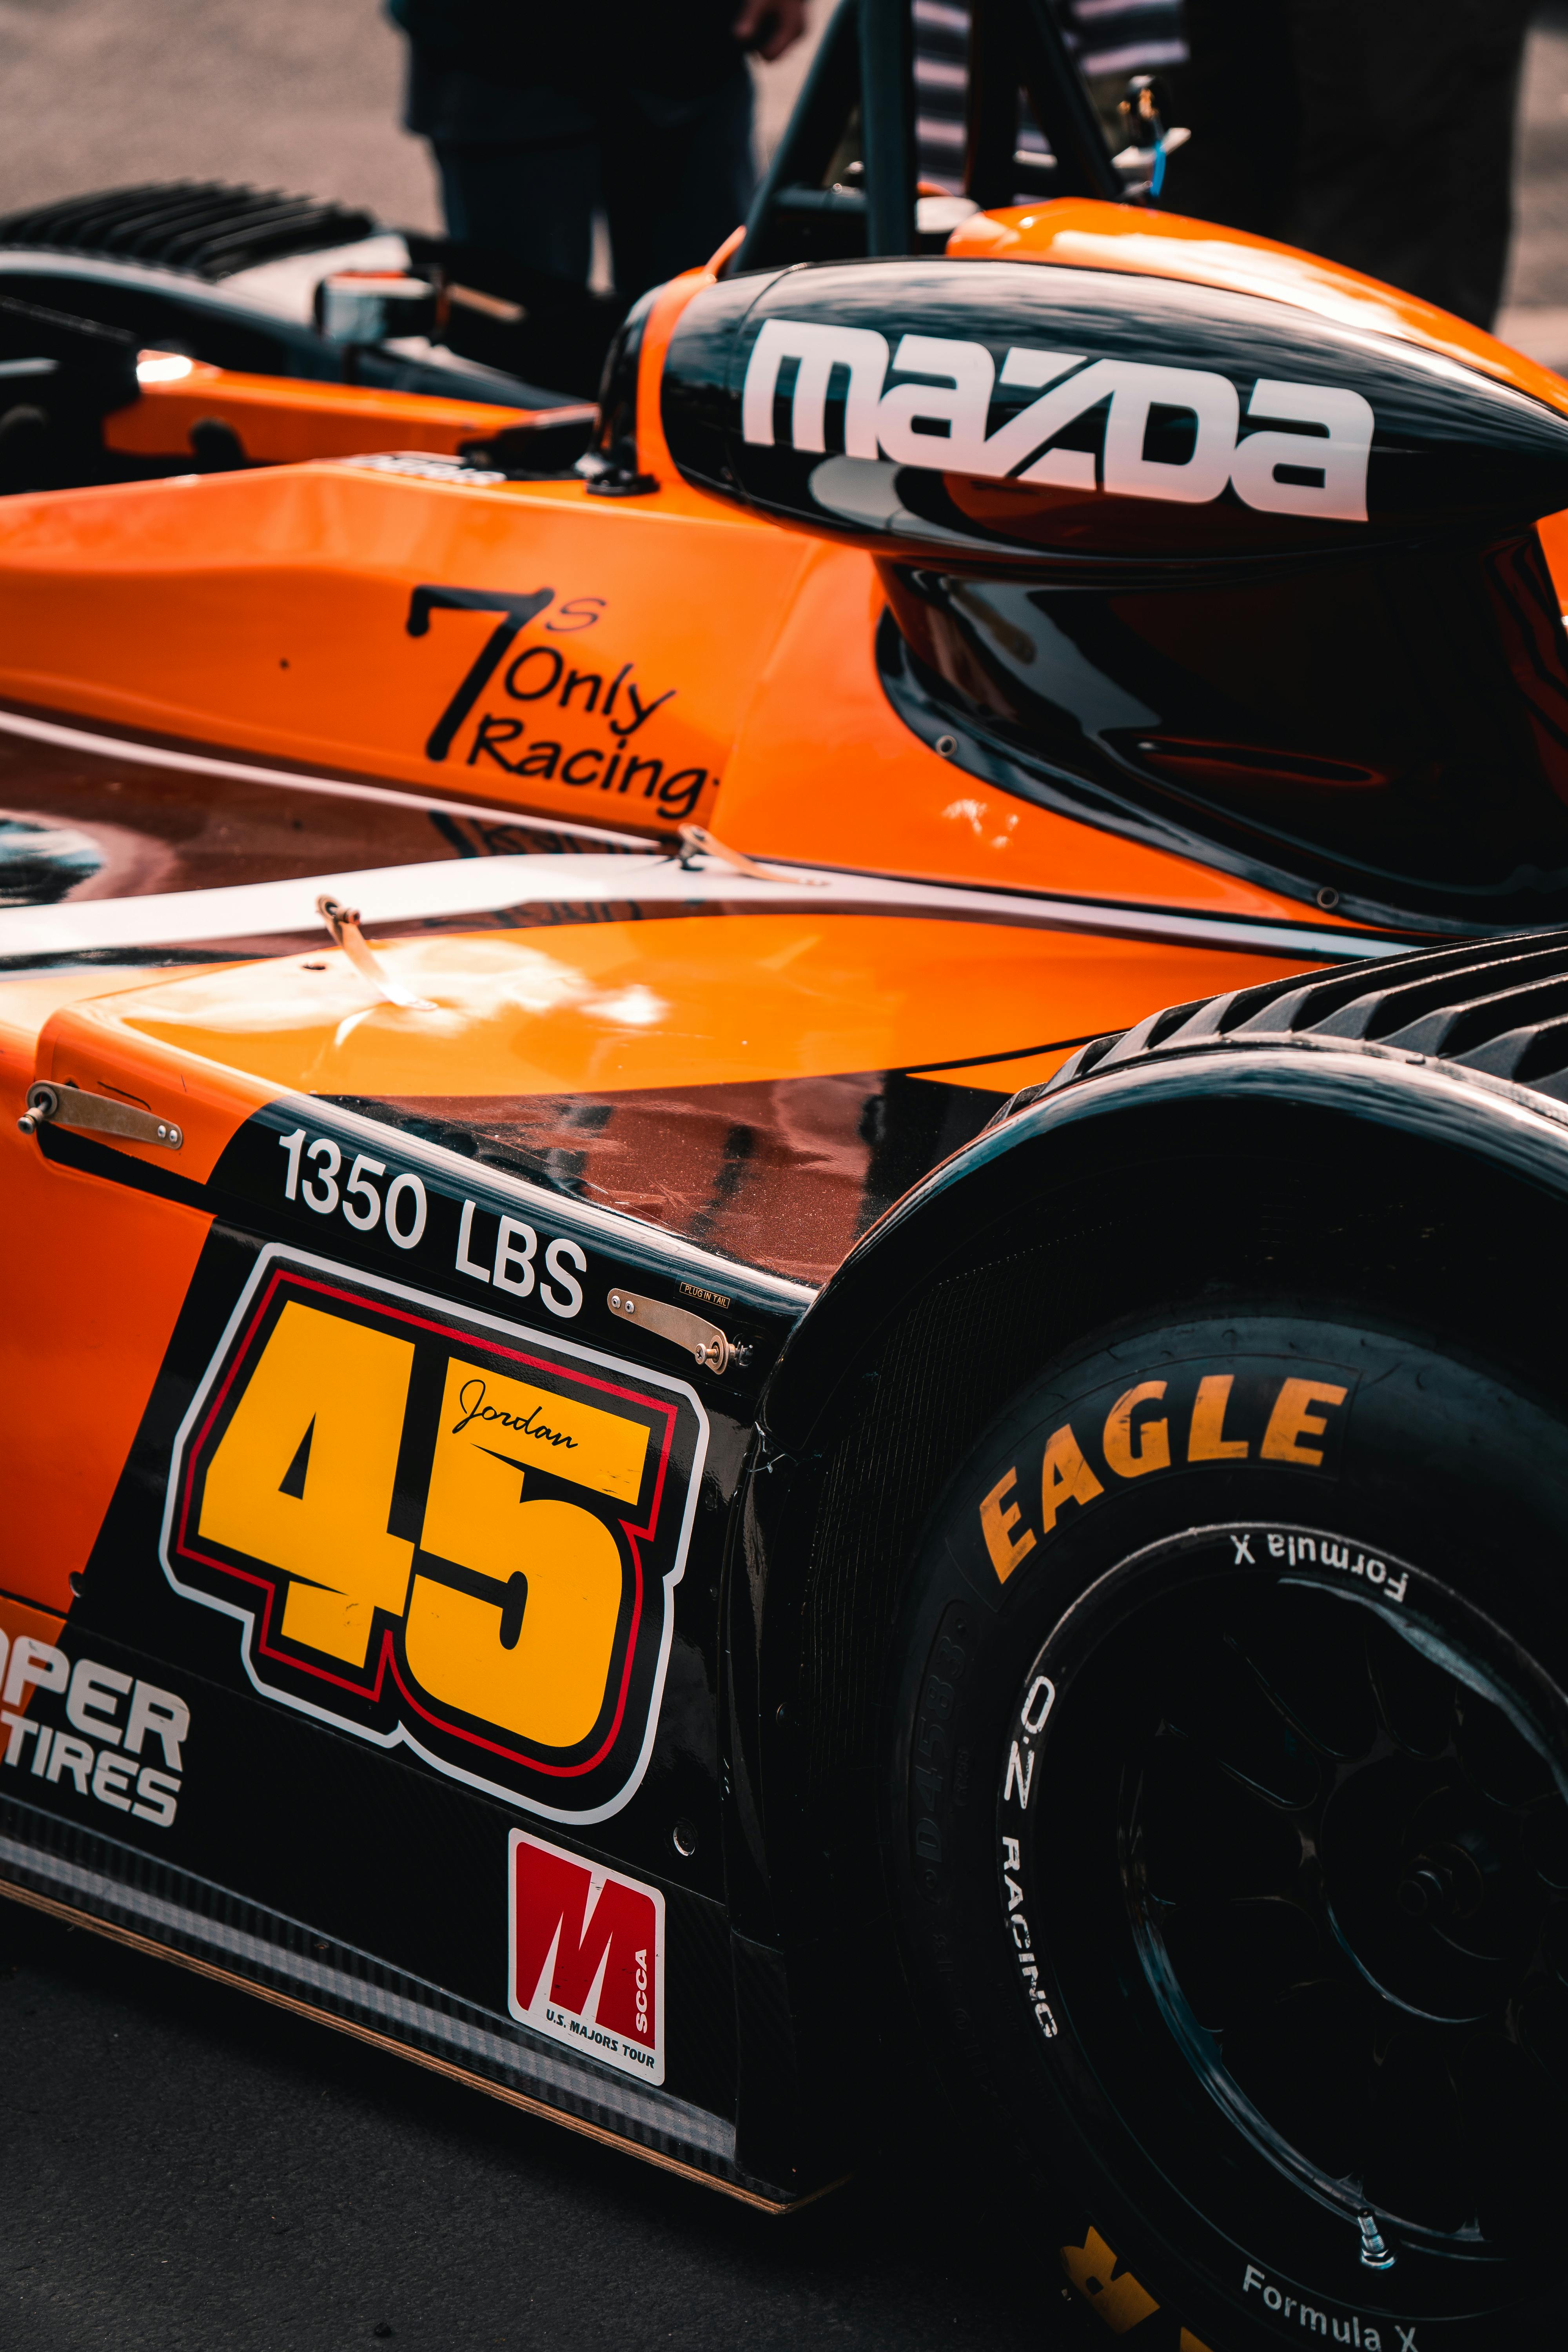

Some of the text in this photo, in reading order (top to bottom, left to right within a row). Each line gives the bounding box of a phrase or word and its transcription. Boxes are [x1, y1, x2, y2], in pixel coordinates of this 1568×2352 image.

[505, 646, 677, 736] Only
[279, 1128, 586, 1318] 1350 LBS
[685, 1285, 727, 1307] PLUG IN TAIL
[452, 1379, 578, 1449] Jordan
[198, 1300, 650, 1747] 45
[979, 1374, 1348, 1584] EAGLE
[1229, 1533, 1410, 1602] Formula X
[0, 1627, 191, 1773] PER
[0, 1709, 181, 1828] TIRES
[1002, 1836, 1058, 2038] RACING
[635, 1949, 647, 2034] SCCA
[546, 2009, 655, 2069] U.S. MAJORS TOUR
[1242, 2263, 1419, 2352] Formula X
